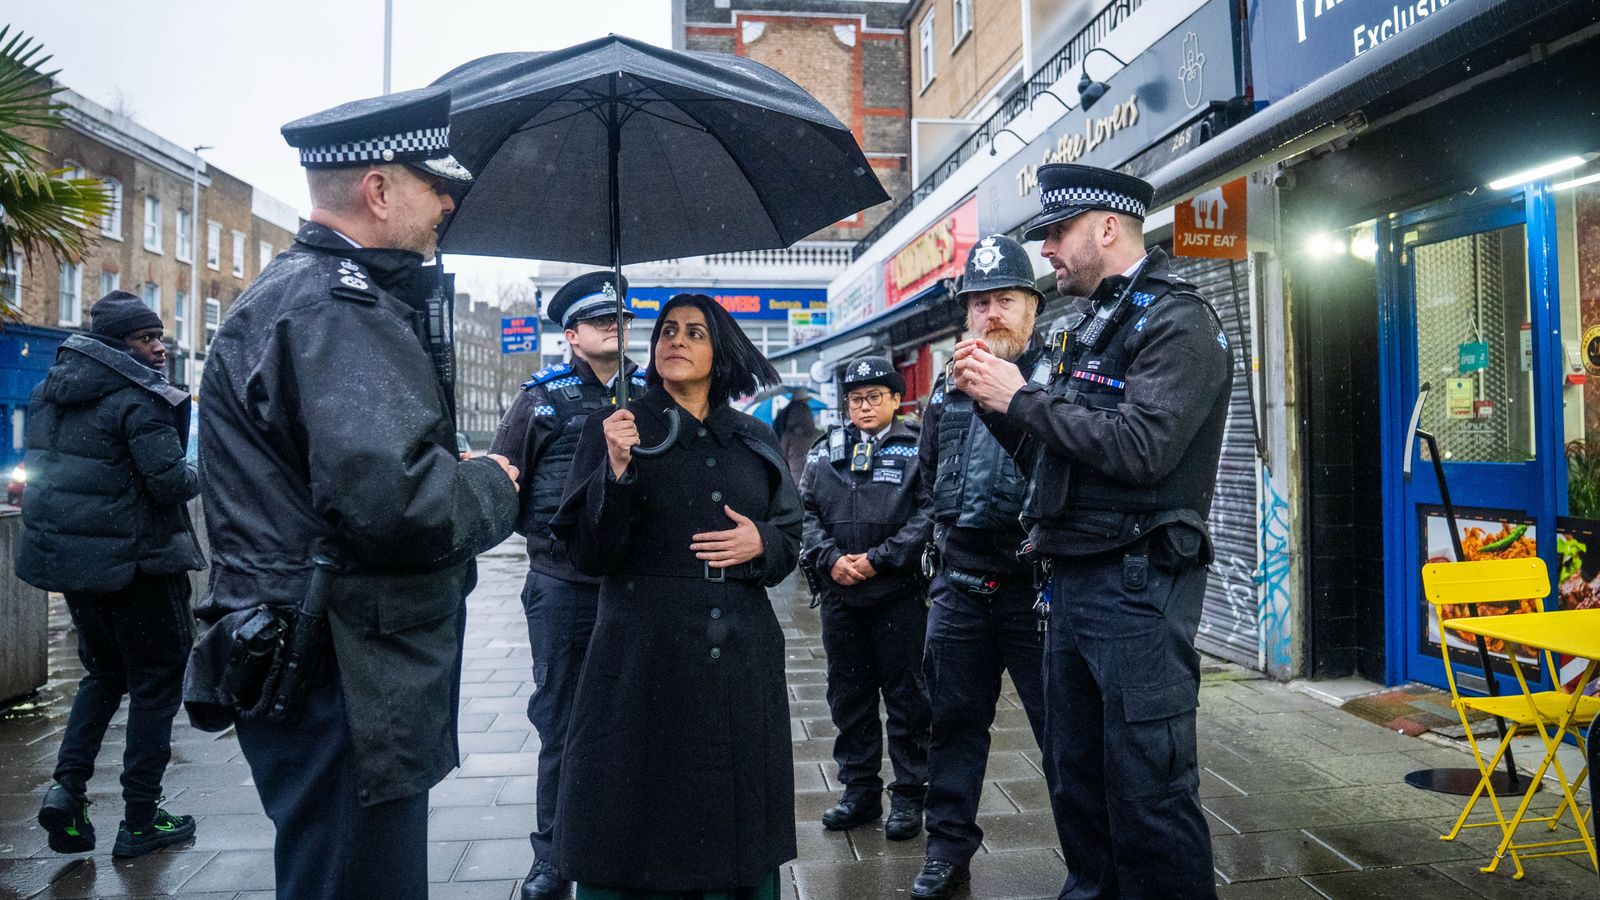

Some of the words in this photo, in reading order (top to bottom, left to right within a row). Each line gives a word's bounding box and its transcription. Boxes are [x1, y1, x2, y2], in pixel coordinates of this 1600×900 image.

[1016, 164, 1039, 197] The
[1086, 94, 1138, 152] Lovers
[1171, 126, 1192, 153] 268
[1182, 232, 1211, 246] JUST
[1213, 235, 1238, 247] EAT
